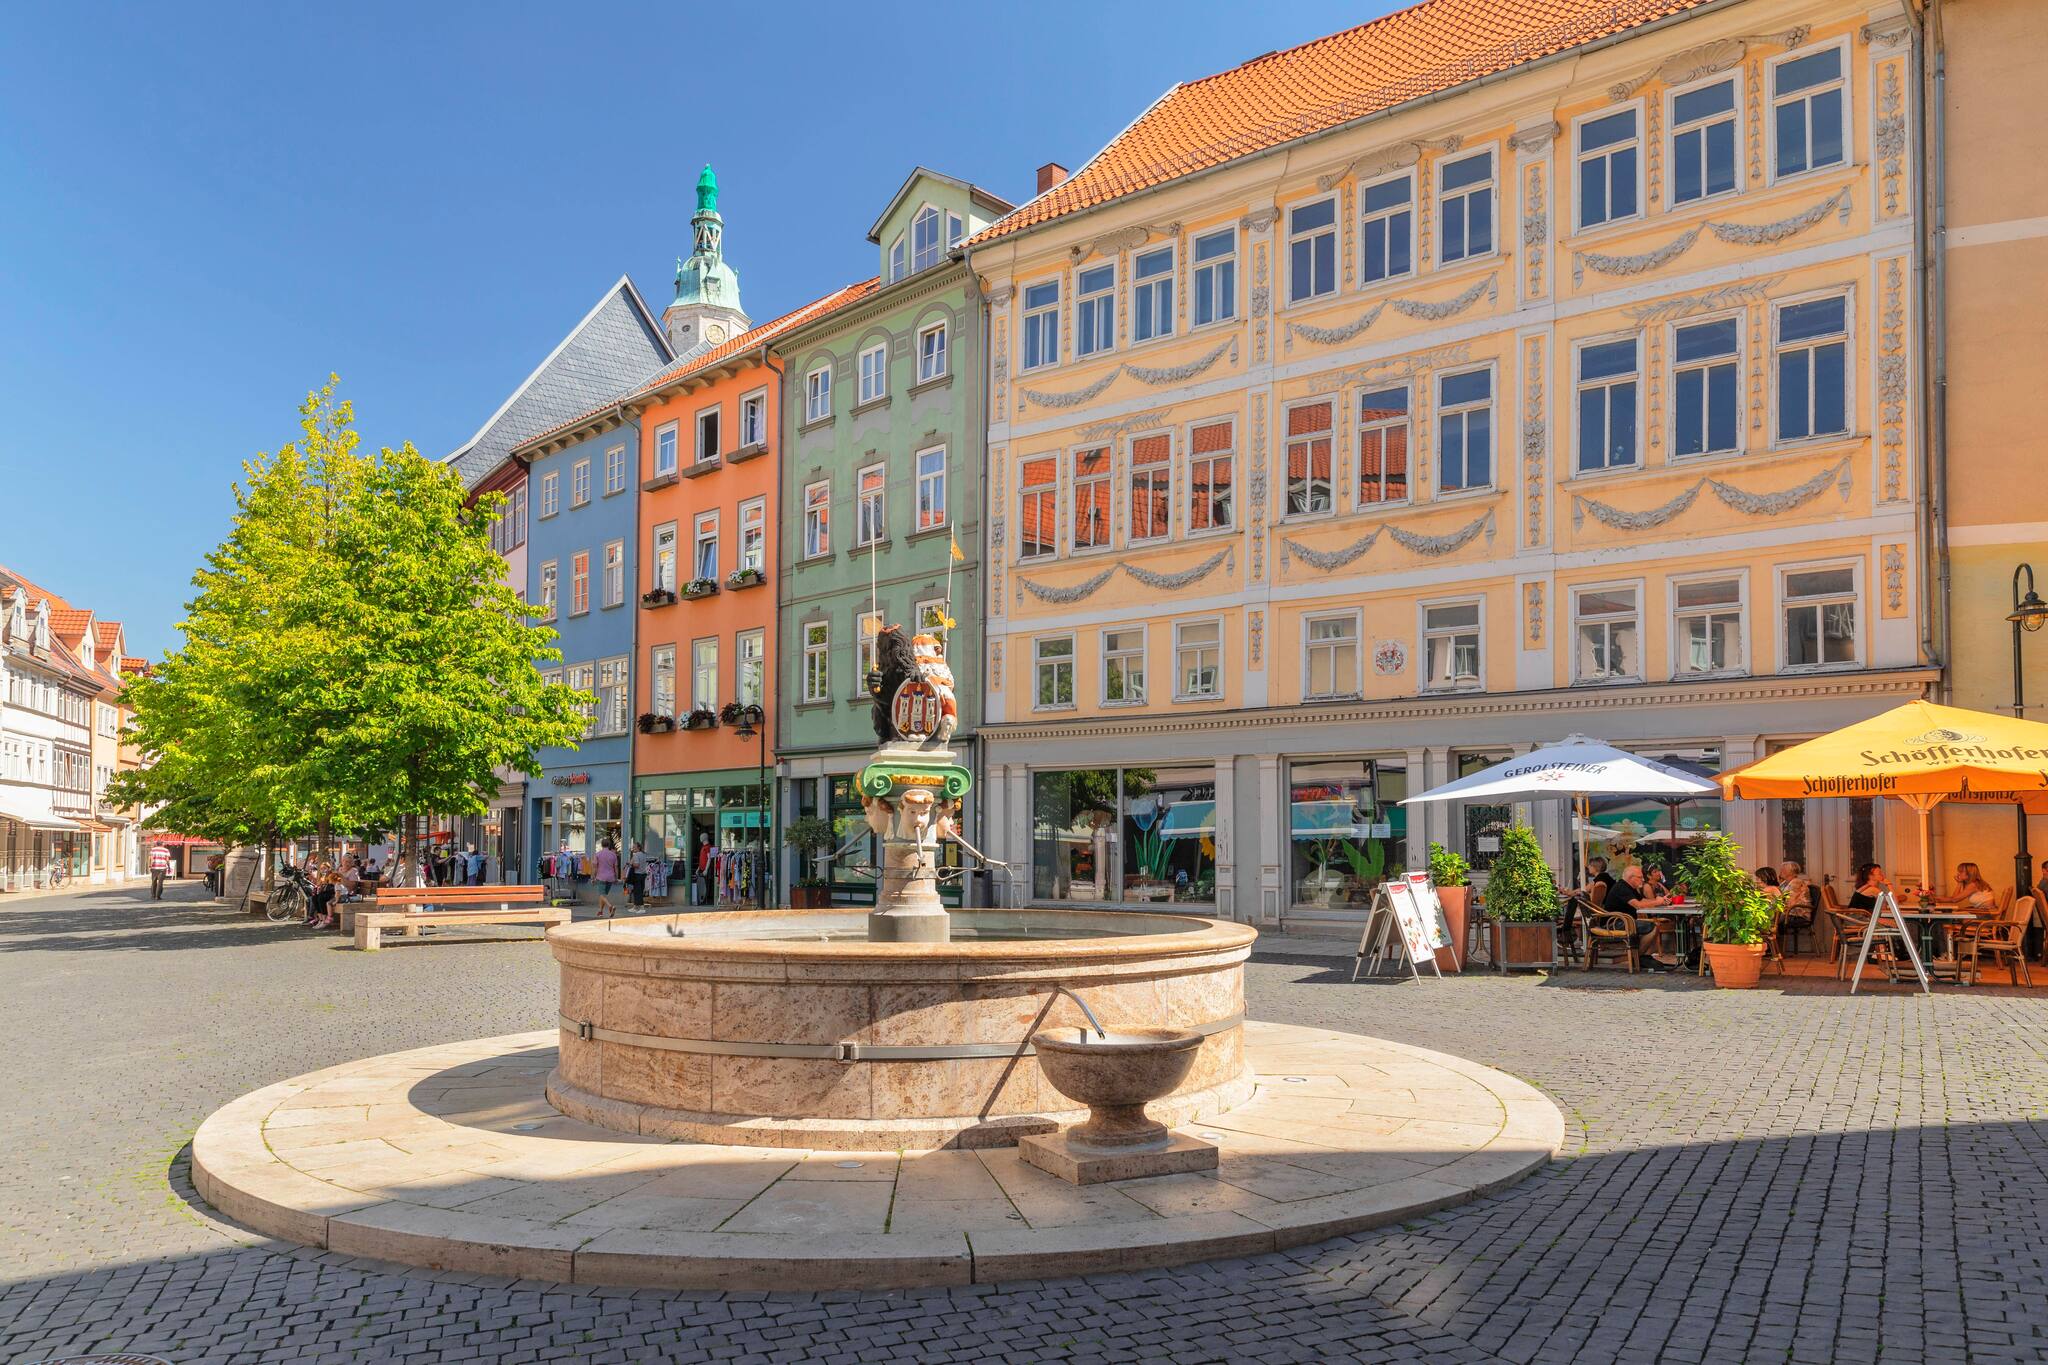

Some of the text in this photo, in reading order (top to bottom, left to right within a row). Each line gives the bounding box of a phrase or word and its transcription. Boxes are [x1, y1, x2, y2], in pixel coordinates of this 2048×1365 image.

[1860, 744, 2048, 766] Schöfferhofer
[1503, 761, 1608, 778] GEROLSTEINER
[1802, 772, 1898, 795] Schöfferhofer
